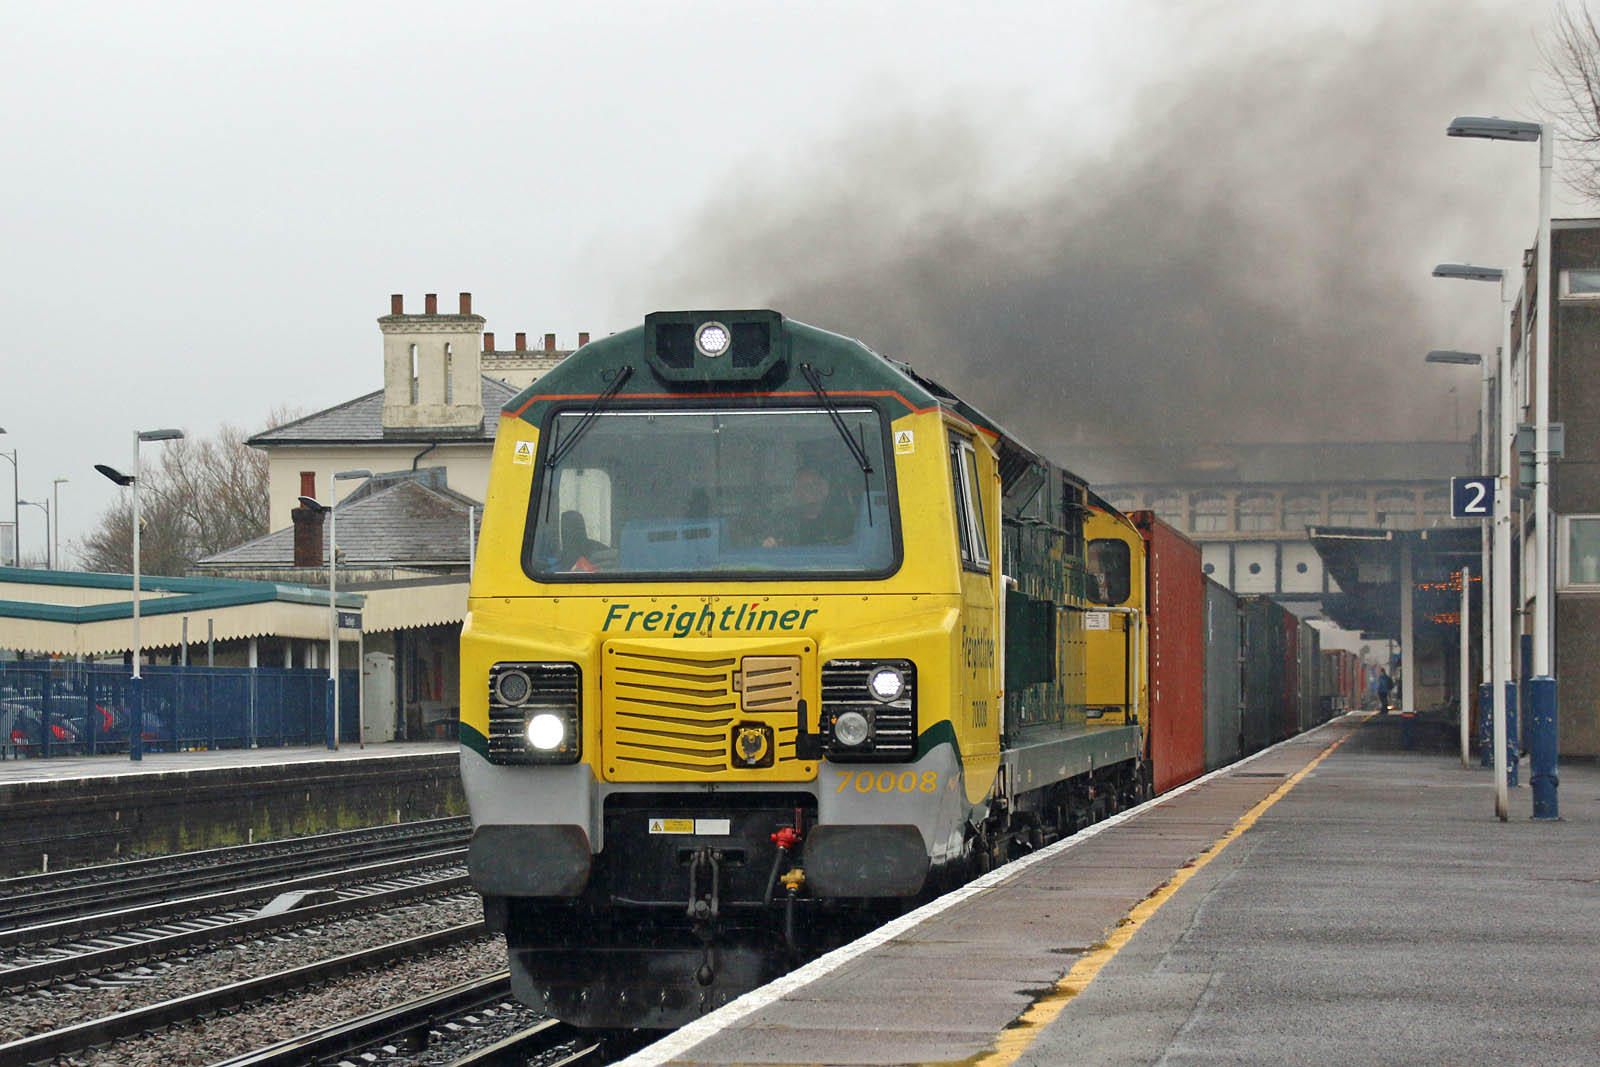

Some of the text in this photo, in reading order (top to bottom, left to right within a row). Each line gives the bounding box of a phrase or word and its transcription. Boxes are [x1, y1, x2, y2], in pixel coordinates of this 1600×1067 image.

[1464, 482, 1486, 513] 2
[602, 603, 818, 638] Freightliner
[962, 624, 995, 680] Freightliner
[836, 770, 938, 793] 70008
